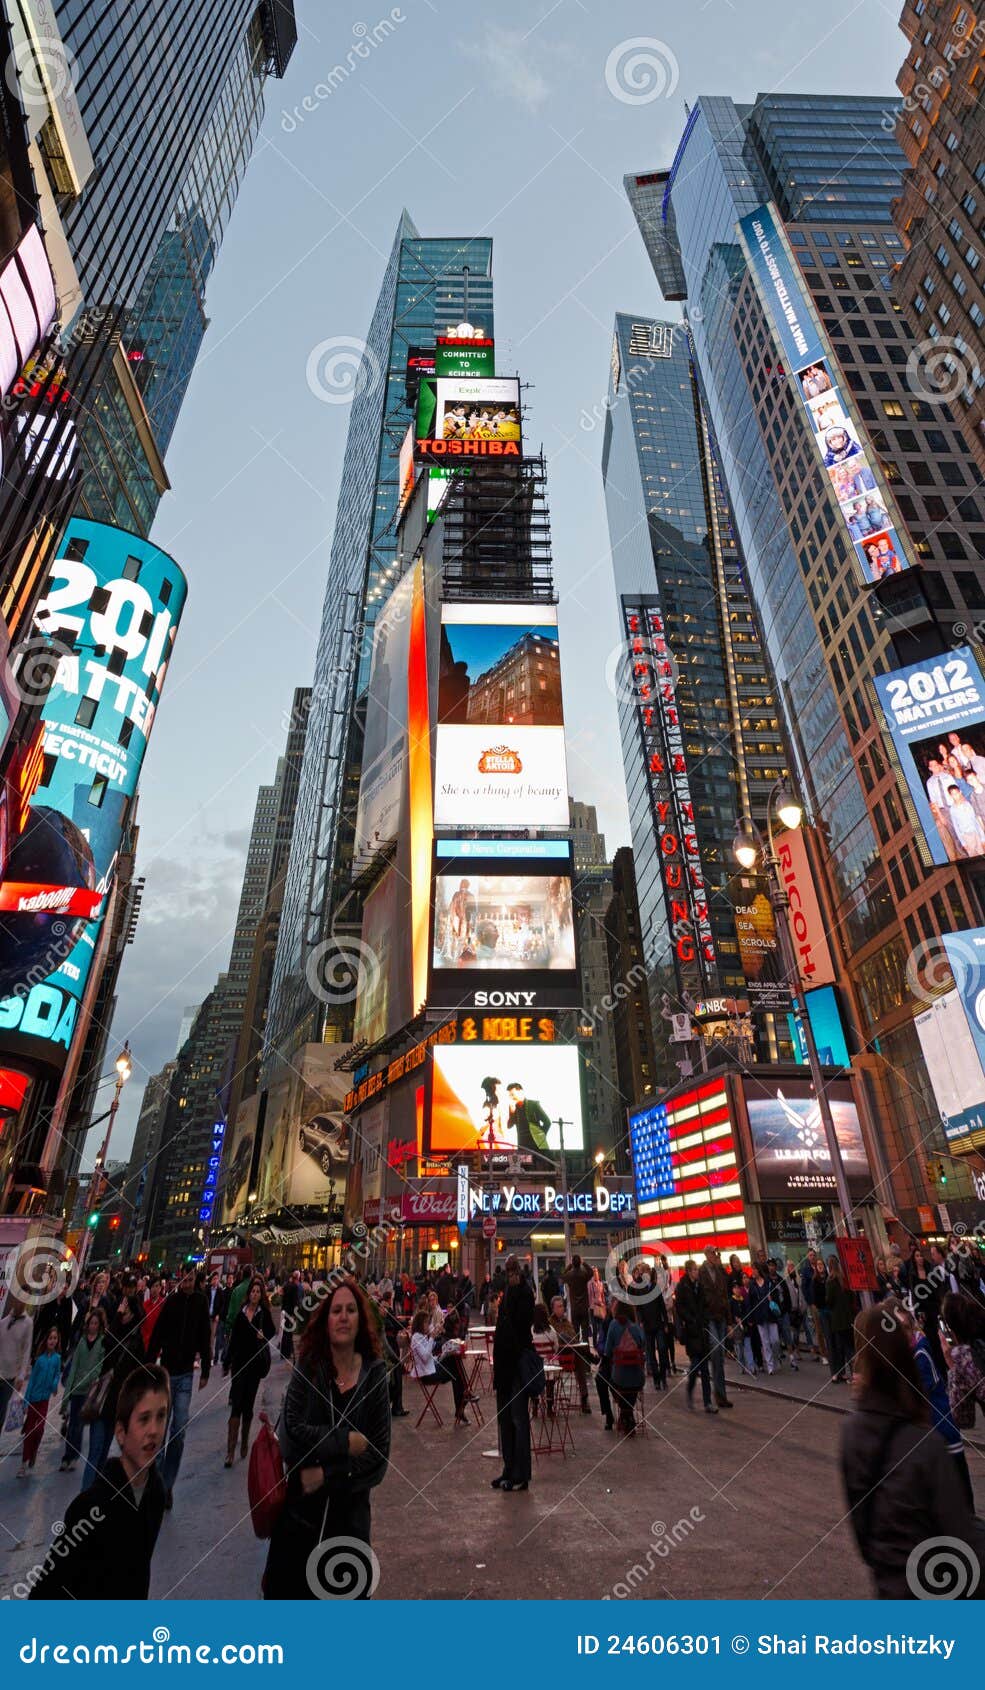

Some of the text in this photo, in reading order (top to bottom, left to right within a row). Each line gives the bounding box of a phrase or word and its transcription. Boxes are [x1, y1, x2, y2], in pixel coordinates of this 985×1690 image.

[765, 254, 780, 280] MOST
[774, 278, 797, 324] MATTERS
[438, 337, 493, 347] TOSHIBA
[447, 326, 485, 339] 2012
[791, 323, 808, 356] WHAT
[443, 351, 487, 359] COMMITTED
[416, 439, 520, 456] TOSHIBA
[33, 559, 171, 679] 201
[51, 655, 152, 738] ATTE
[886, 659, 975, 711] 2012
[894, 688, 981, 725] MATTERS
[44, 732, 128, 786] ECTICUT
[441, 783, 457, 796] She
[482, 783, 511, 799] thing
[527, 784, 562, 800] beauty
[655, 801, 695, 962] YOUNG
[18, 887, 77, 913] kaboom!
[735, 905, 758, 916] DEAD
[778, 843, 817, 975] RICOH
[738, 921, 754, 931] SEA
[741, 938, 777, 948] SCROLLS
[474, 991, 537, 1007] SONY
[706, 1001, 727, 1013] NBC
[0, 982, 79, 1051] SDA
[461, 1017, 478, 1041] &
[482, 1017, 534, 1041] NOBLE
[813, 1149, 849, 1160] FOE
[459, 1167, 467, 1219] NYPD
[502, 1186, 540, 1212] YORK
[595, 1186, 632, 1212] DEPT
[409, 1193, 460, 1220] Walg
